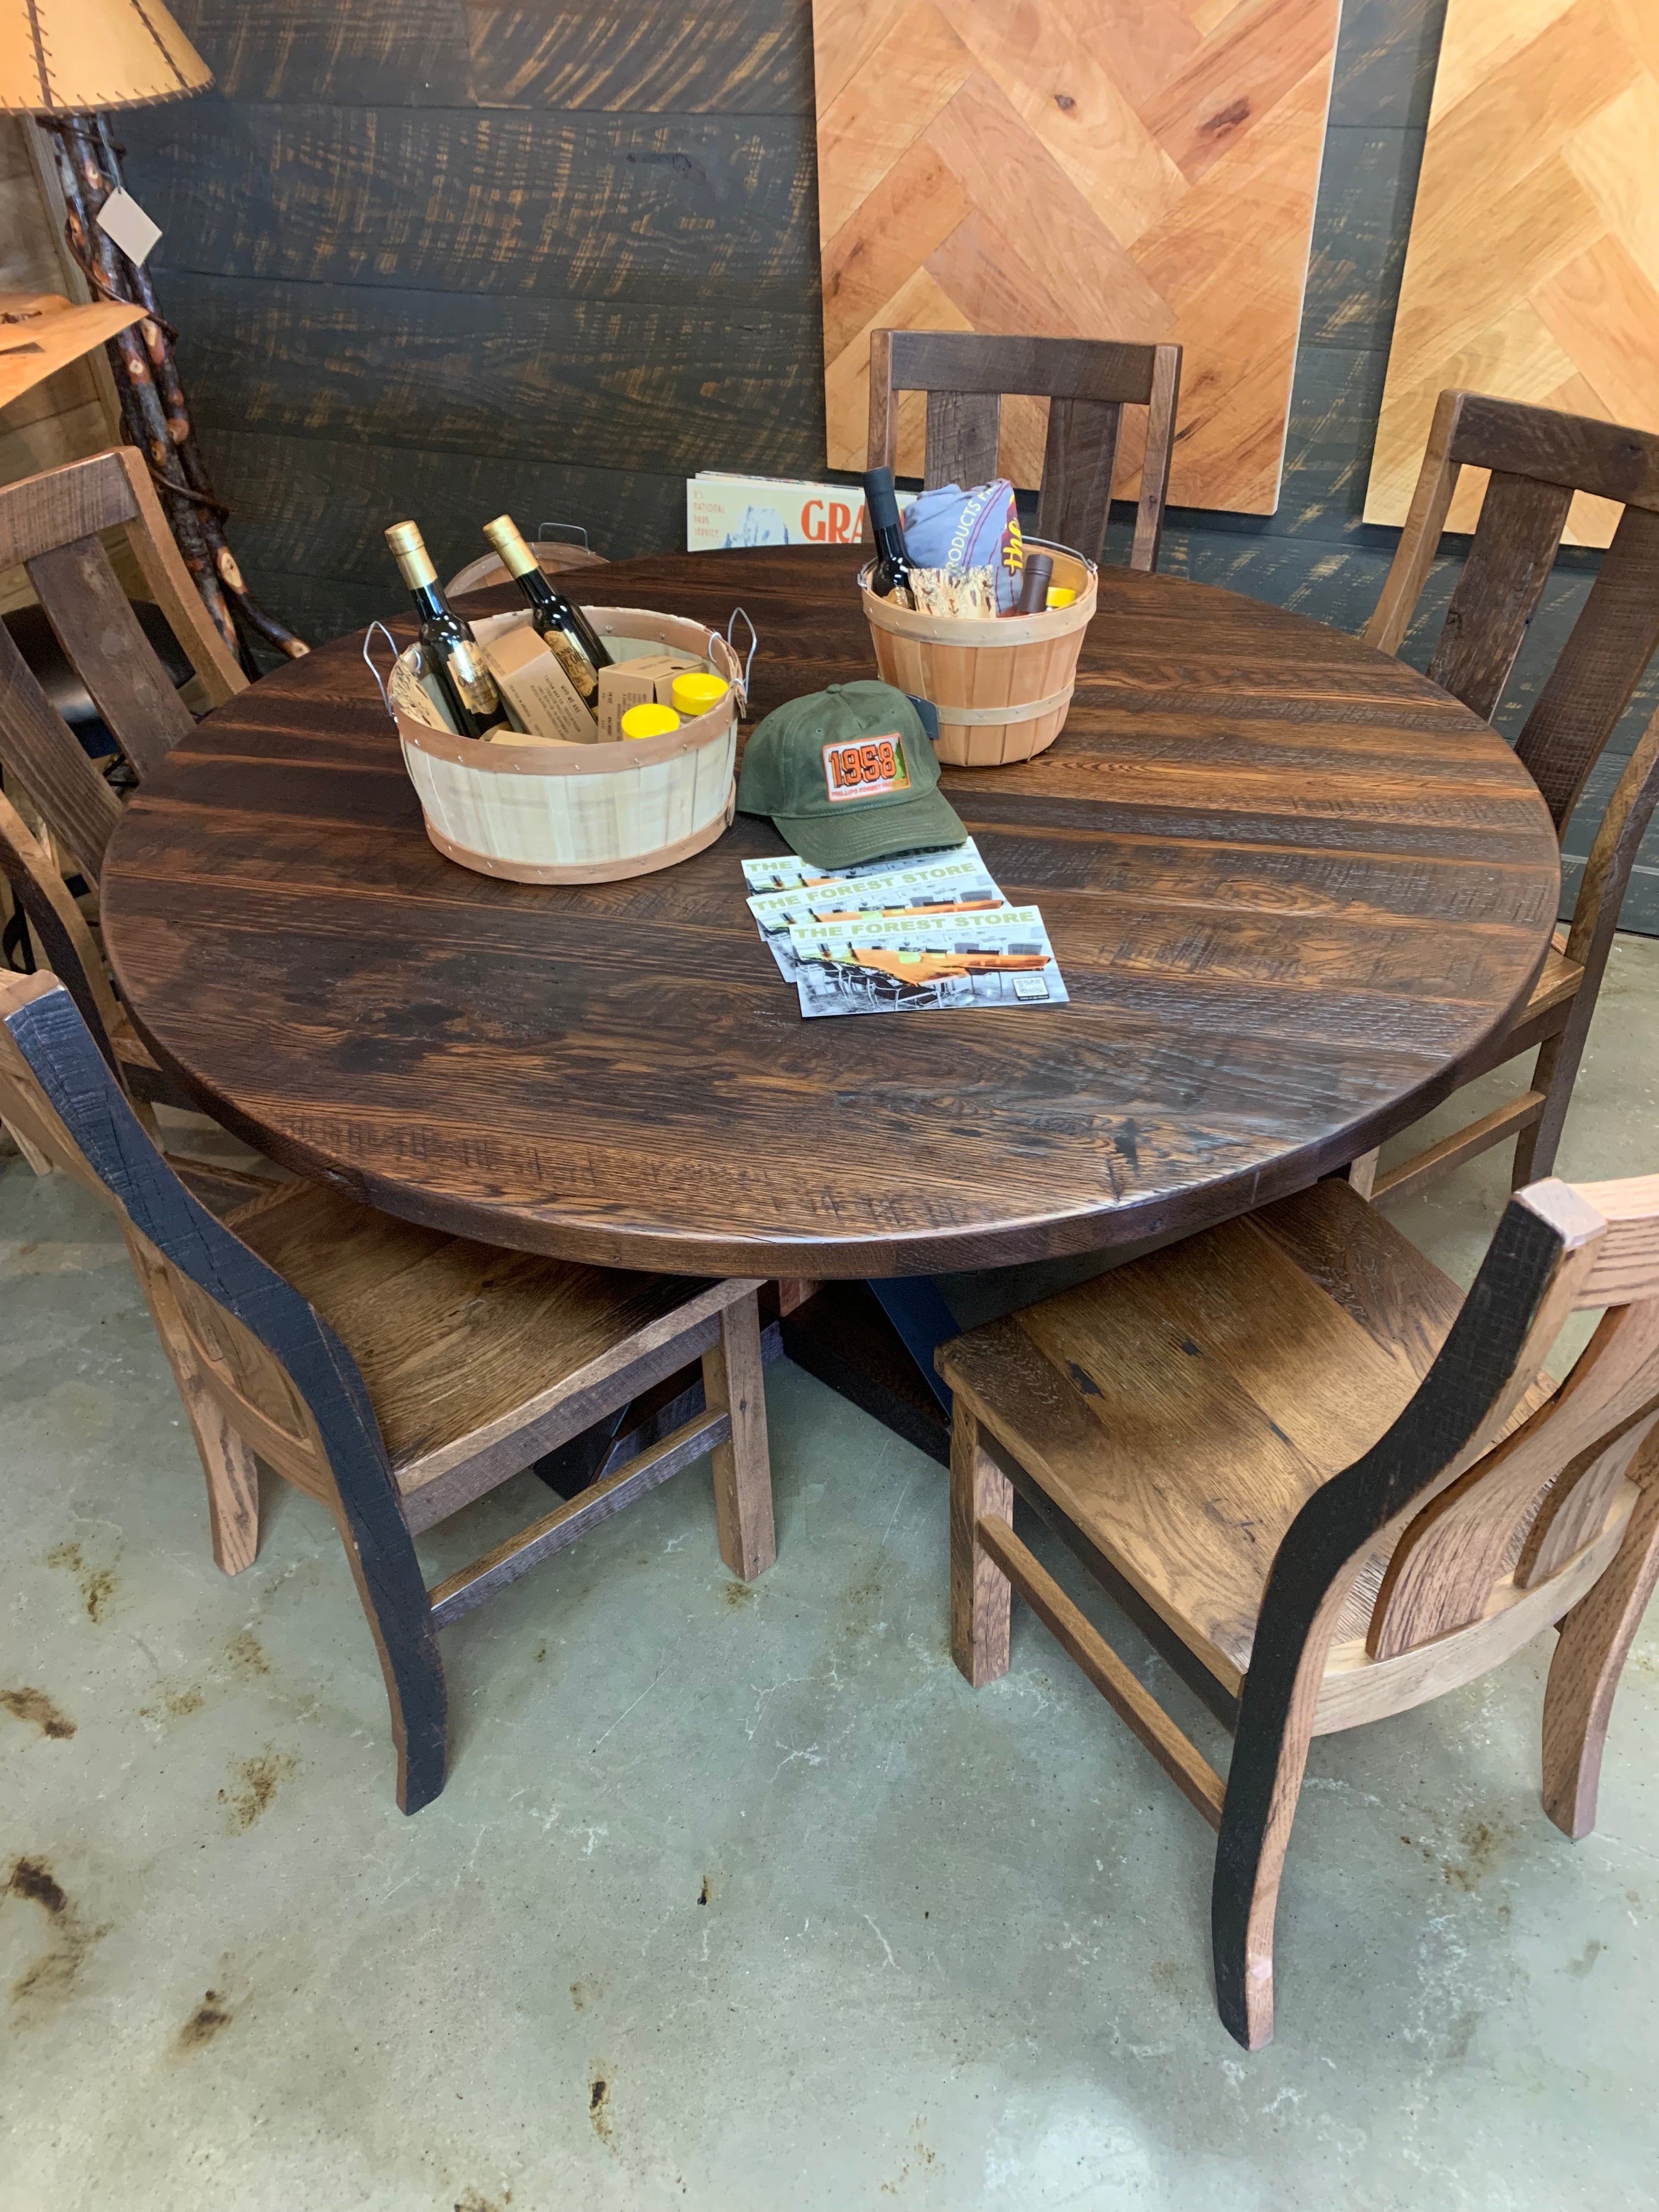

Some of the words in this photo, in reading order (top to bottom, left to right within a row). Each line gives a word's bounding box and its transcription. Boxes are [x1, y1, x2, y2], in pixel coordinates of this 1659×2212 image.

[693, 502, 725, 514] NATIONAL
[693, 527, 719, 538] SERVICE
[560, 684, 569, 696] WHO
[828, 742, 896, 788] 1958
[747, 861, 793, 872] THE
[752, 895, 801, 911] THE
[806, 877, 893, 901] FOREST
[901, 862, 977, 883] STORE
[794, 926, 843, 939] THE
[851, 918, 946, 935] FOREST
[955, 911, 1035, 927] STORE
